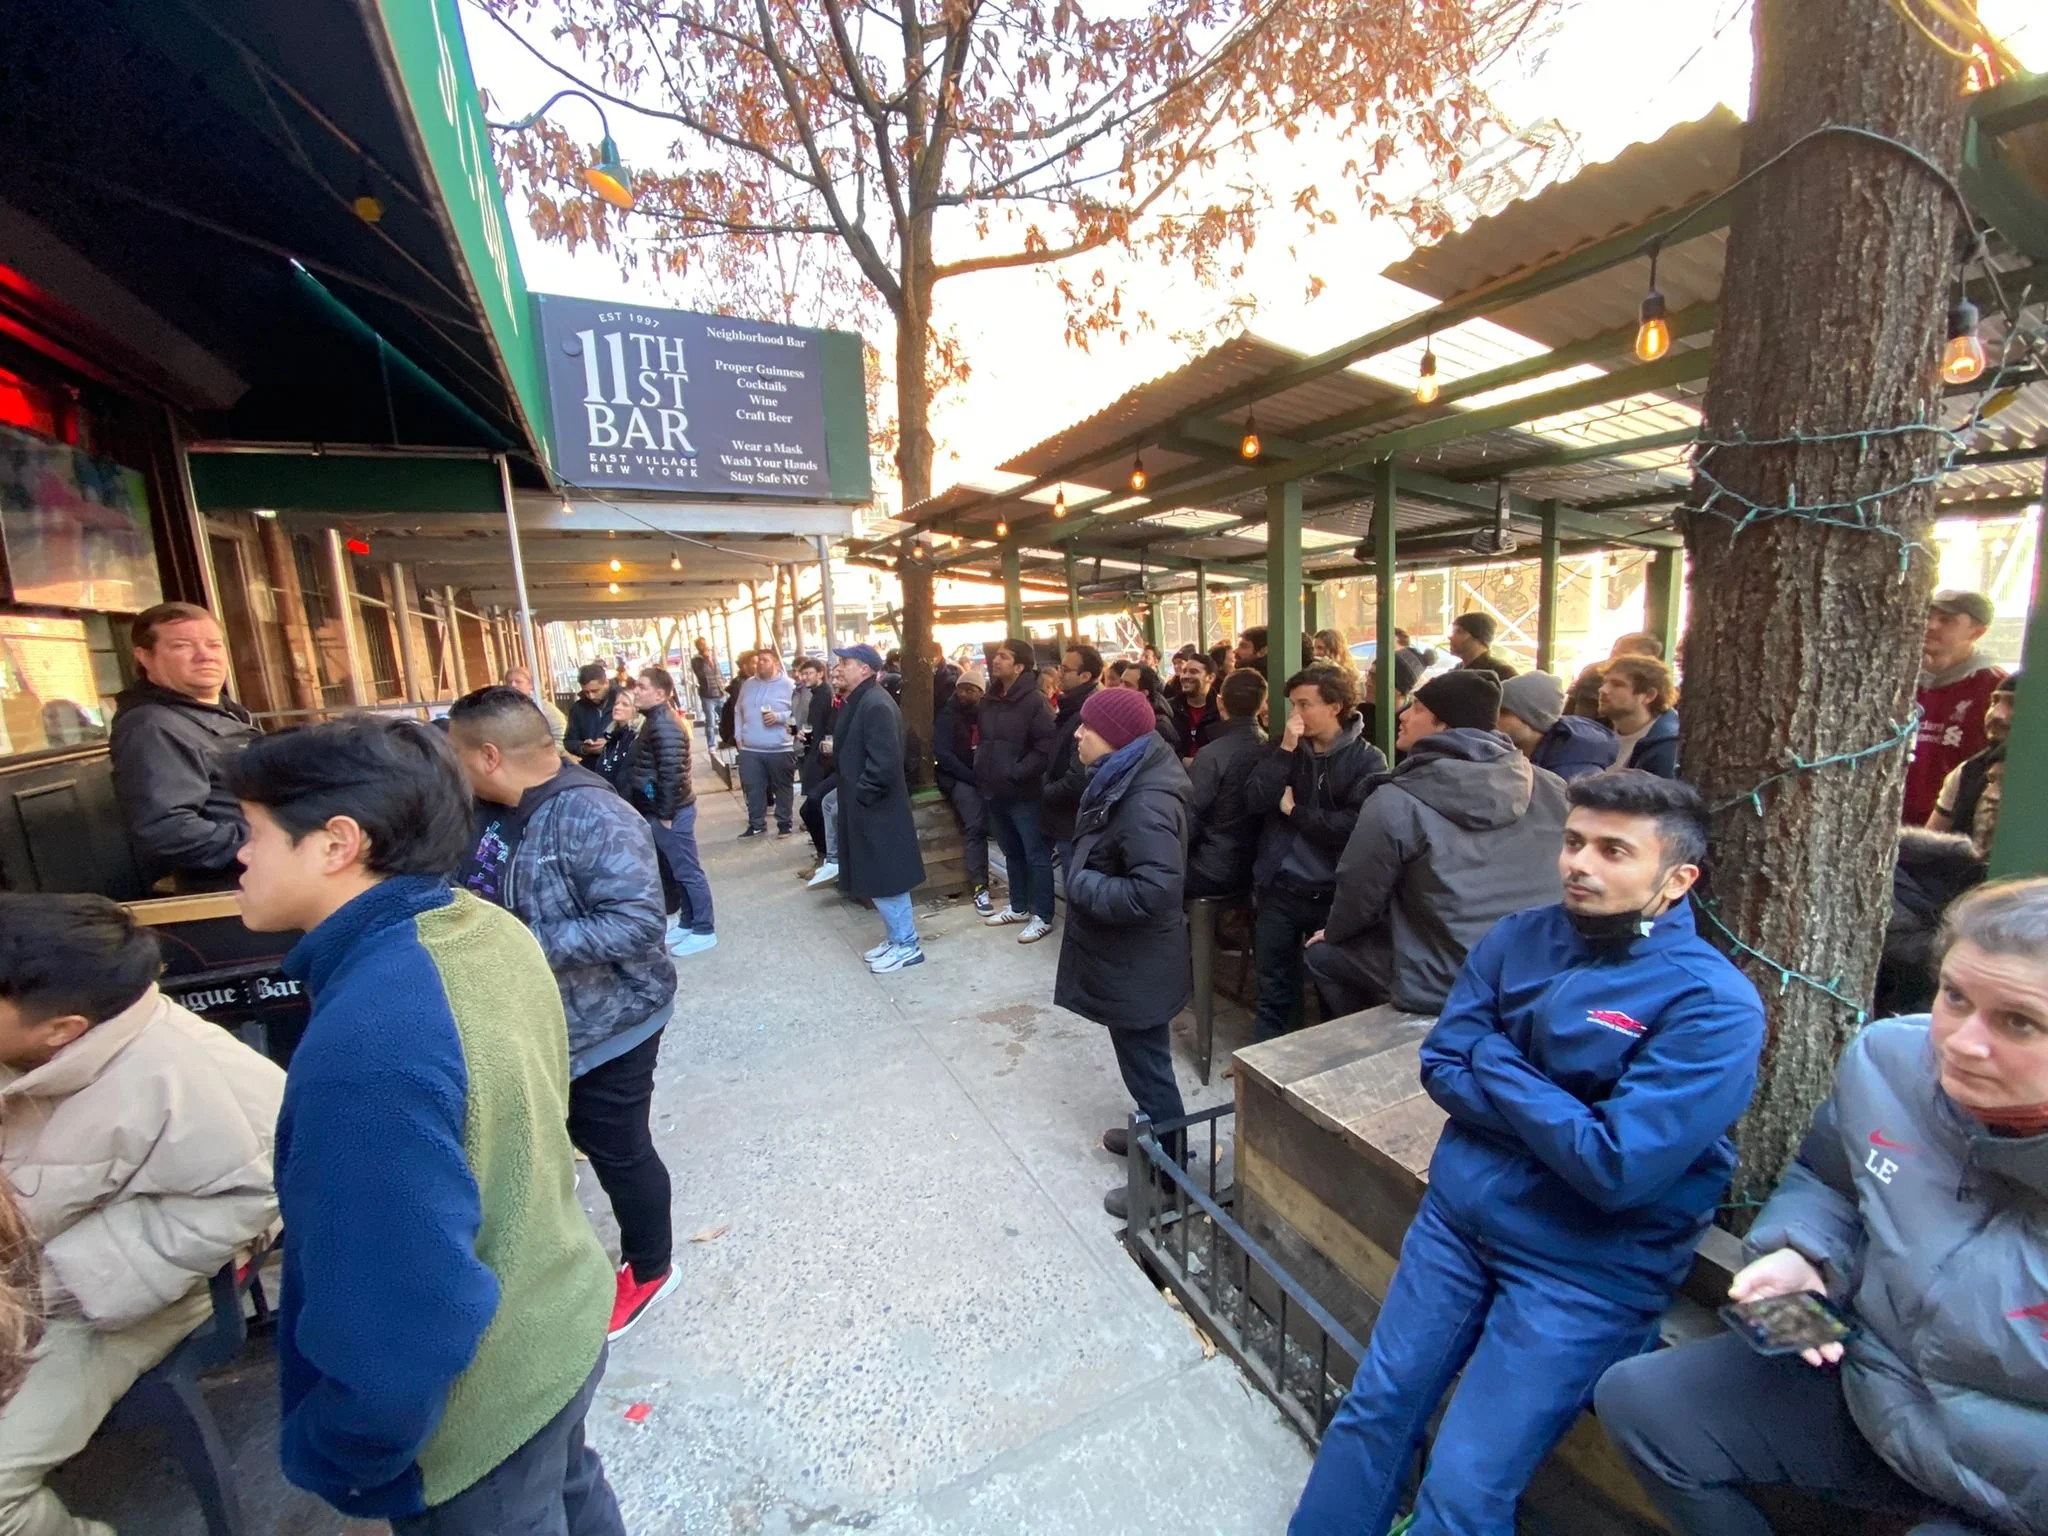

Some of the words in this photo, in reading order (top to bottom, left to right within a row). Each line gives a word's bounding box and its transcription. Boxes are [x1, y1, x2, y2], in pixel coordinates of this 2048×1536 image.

[598, 312, 623, 323] EST
[630, 313, 660, 328] 1997
[706, 327, 785, 347] Neighborhood
[787, 336, 807, 348] Bar
[715, 360, 754, 375] Proper
[756, 364, 805, 379] Guinness
[640, 371, 689, 409] ST
[737, 377, 787, 393] Cocktails
[749, 394, 778, 407] Wine
[736, 409, 766, 422] Craft
[768, 412, 793, 424] Beer
[583, 403, 696, 452] BAR
[732, 440, 763, 452] Wear
[764, 444, 772, 452] a
[774, 442, 804, 454] Mask
[589, 453, 627, 463] EAST
[636, 456, 698, 467] VILLAGE
[720, 455, 752, 466] Wash
[754, 457, 782, 469] Your
[784, 459, 818, 471] Hands
[590, 464, 631, 474] NEW
[648, 467, 699, 478] YORK
[730, 471, 755, 484] Stay
[756, 471, 781, 484] Safe
[782, 474, 809, 486] NYC
[256, 977, 300, 999] Bar
[1865, 1149, 1898, 1184] LE
